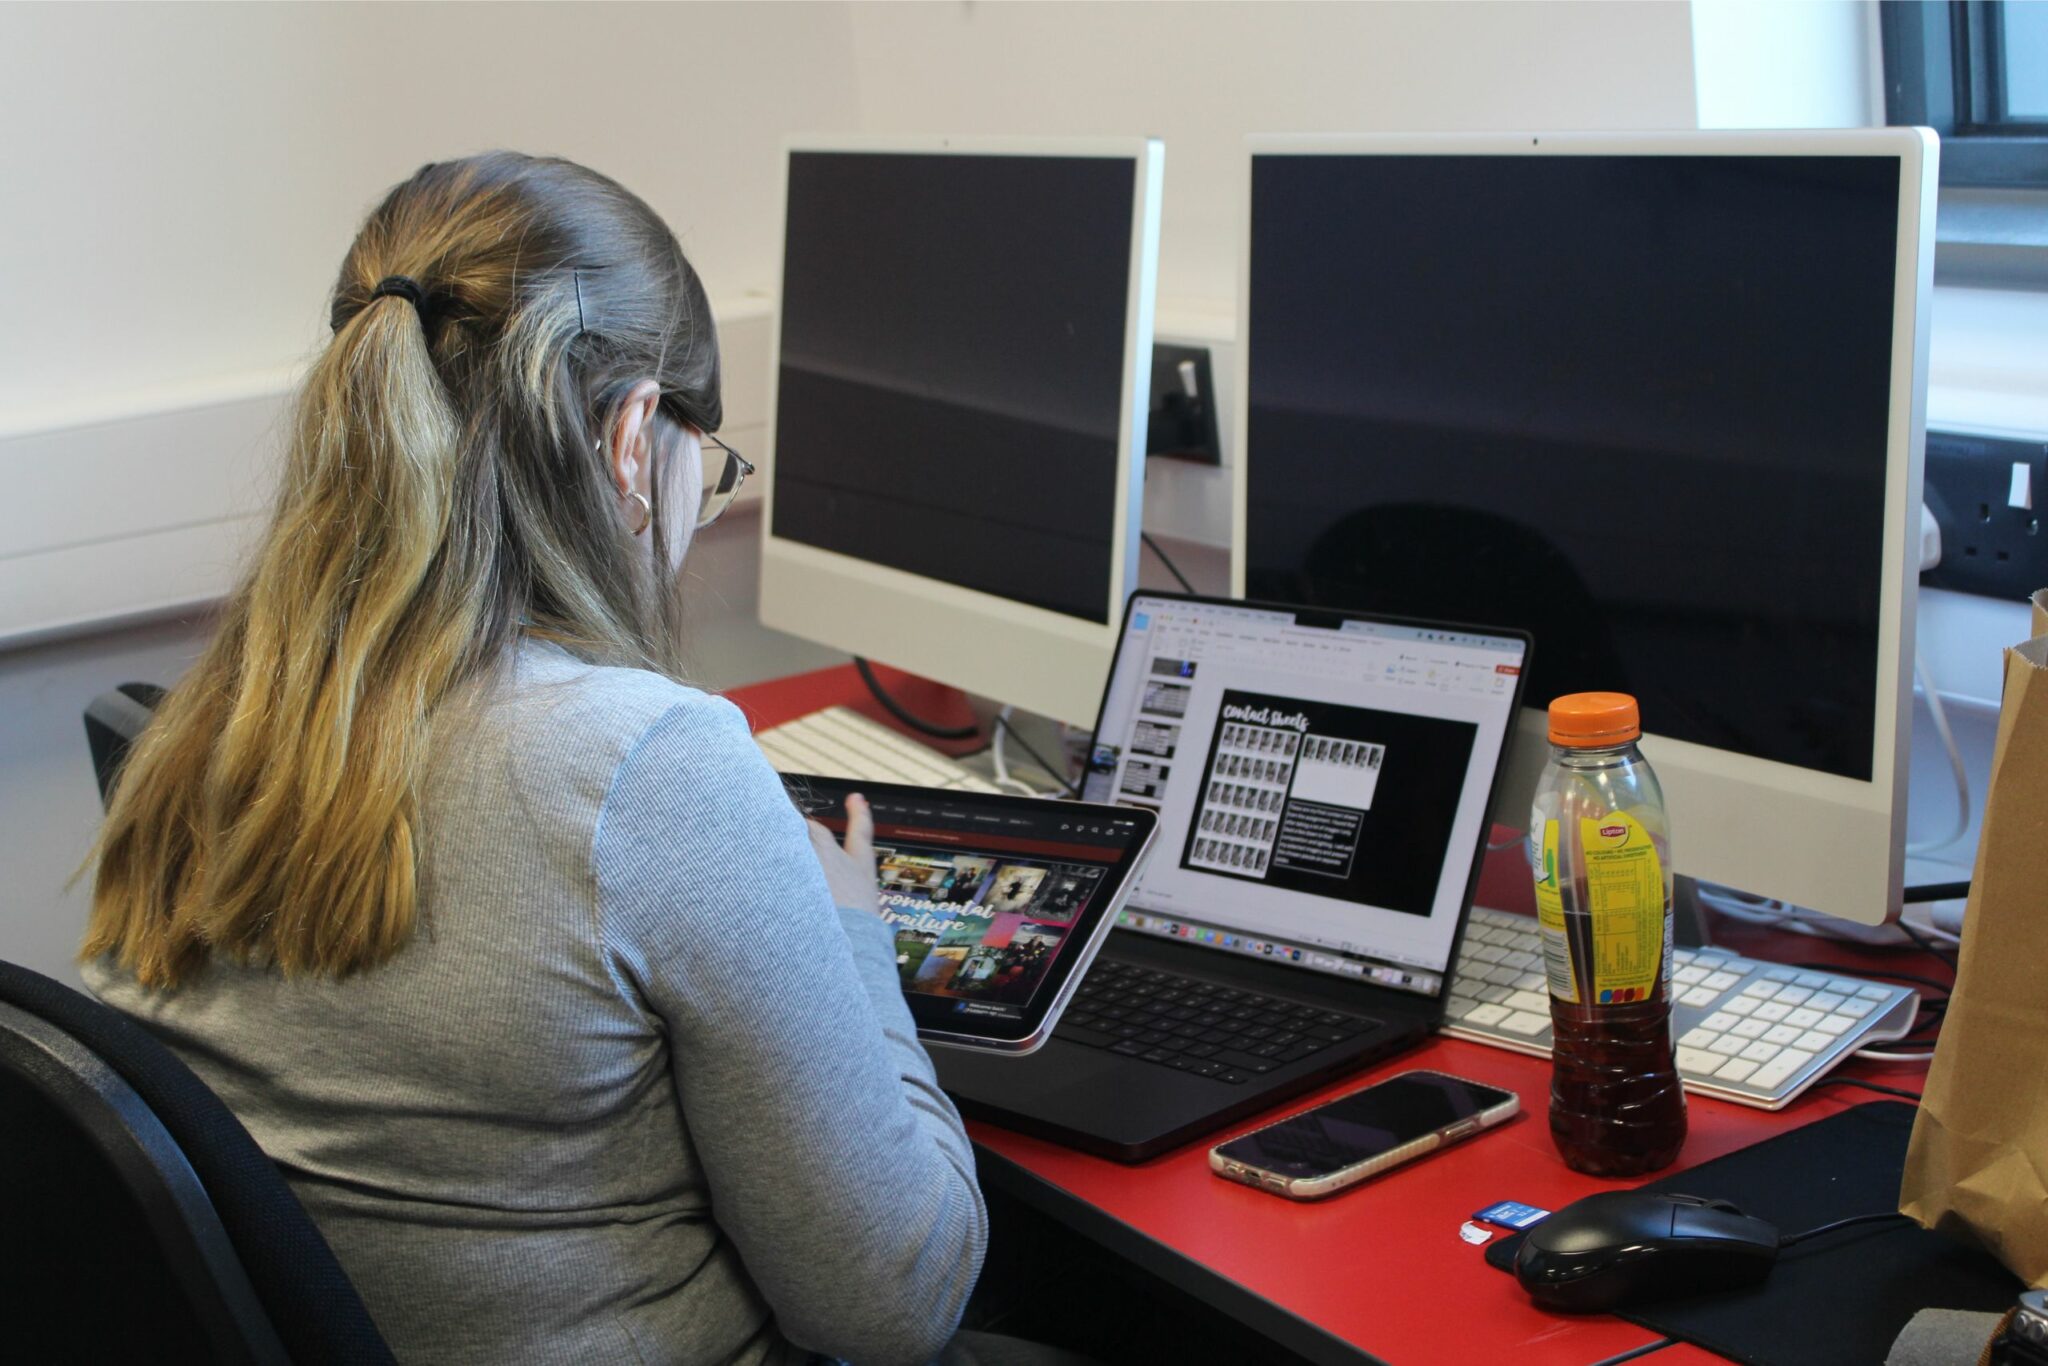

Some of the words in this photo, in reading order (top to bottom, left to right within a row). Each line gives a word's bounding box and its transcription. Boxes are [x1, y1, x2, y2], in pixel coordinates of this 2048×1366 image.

[1601, 827, 1625, 837] Lipton
[878, 893, 996, 919] ronmental
[880, 907, 967, 931] traiture
